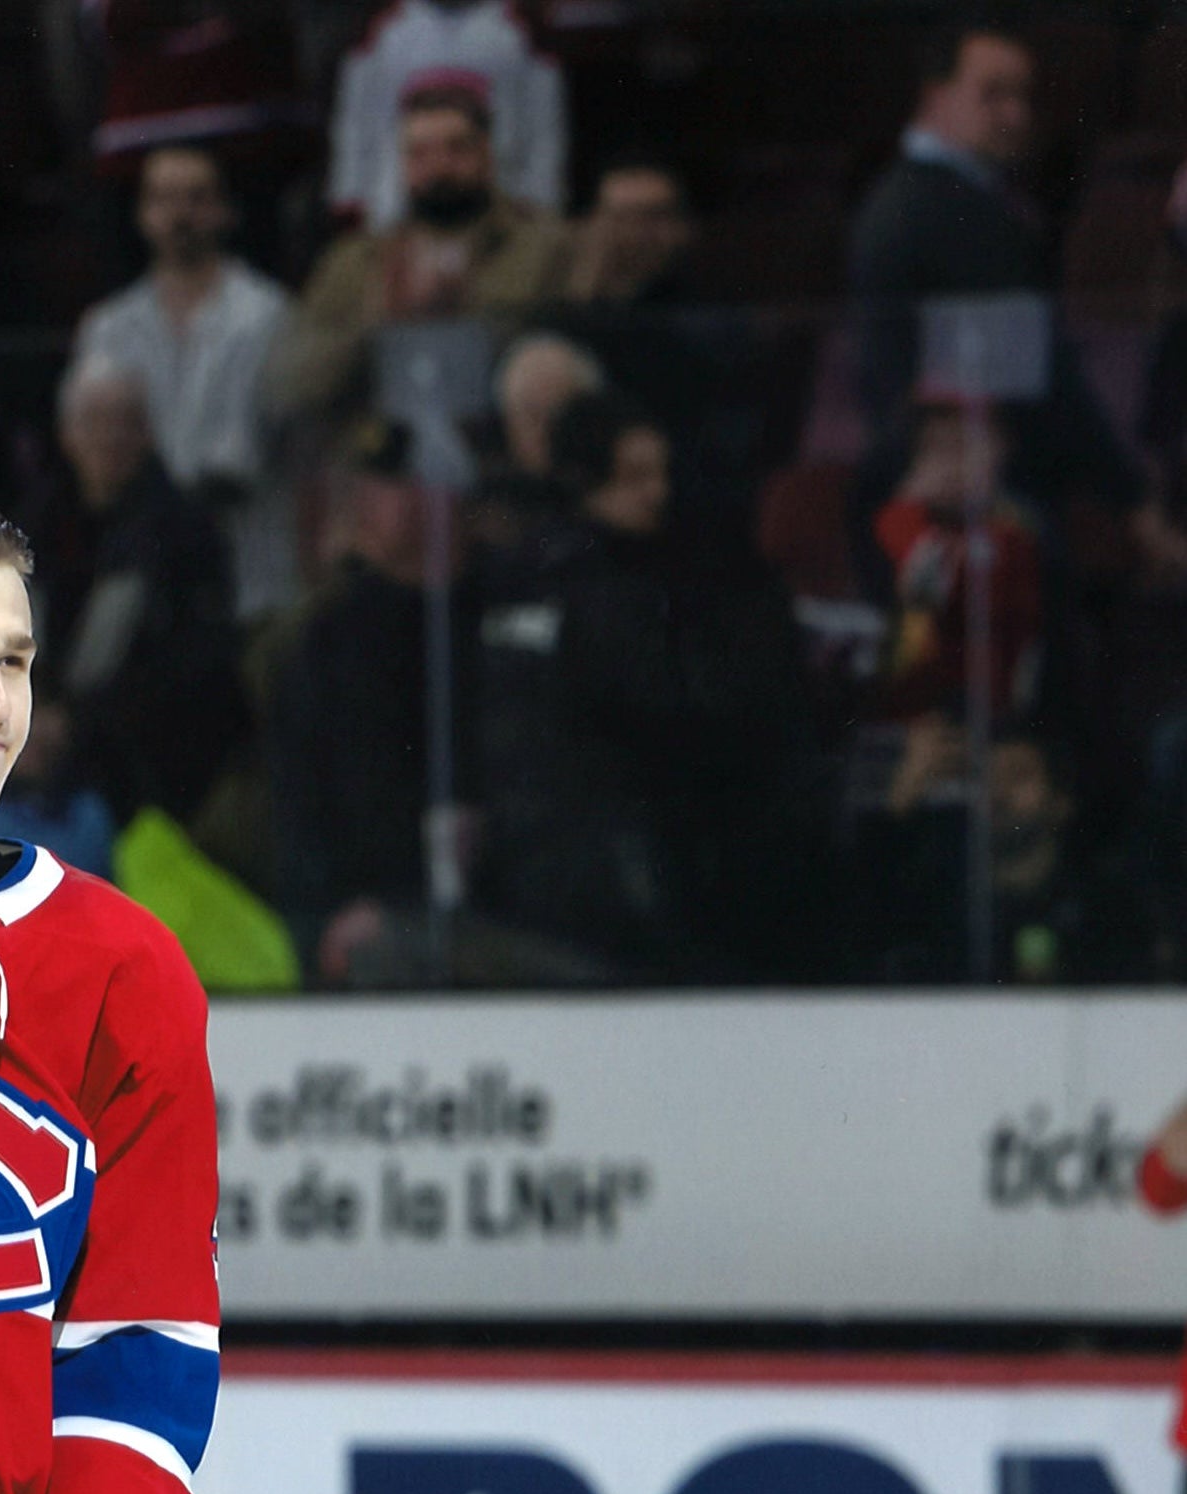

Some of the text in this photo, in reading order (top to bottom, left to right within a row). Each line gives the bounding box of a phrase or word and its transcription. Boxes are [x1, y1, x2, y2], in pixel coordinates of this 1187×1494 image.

[250, 1066, 550, 1146] officielle
[278, 1164, 359, 1243] de
[382, 1160, 449, 1242] la
